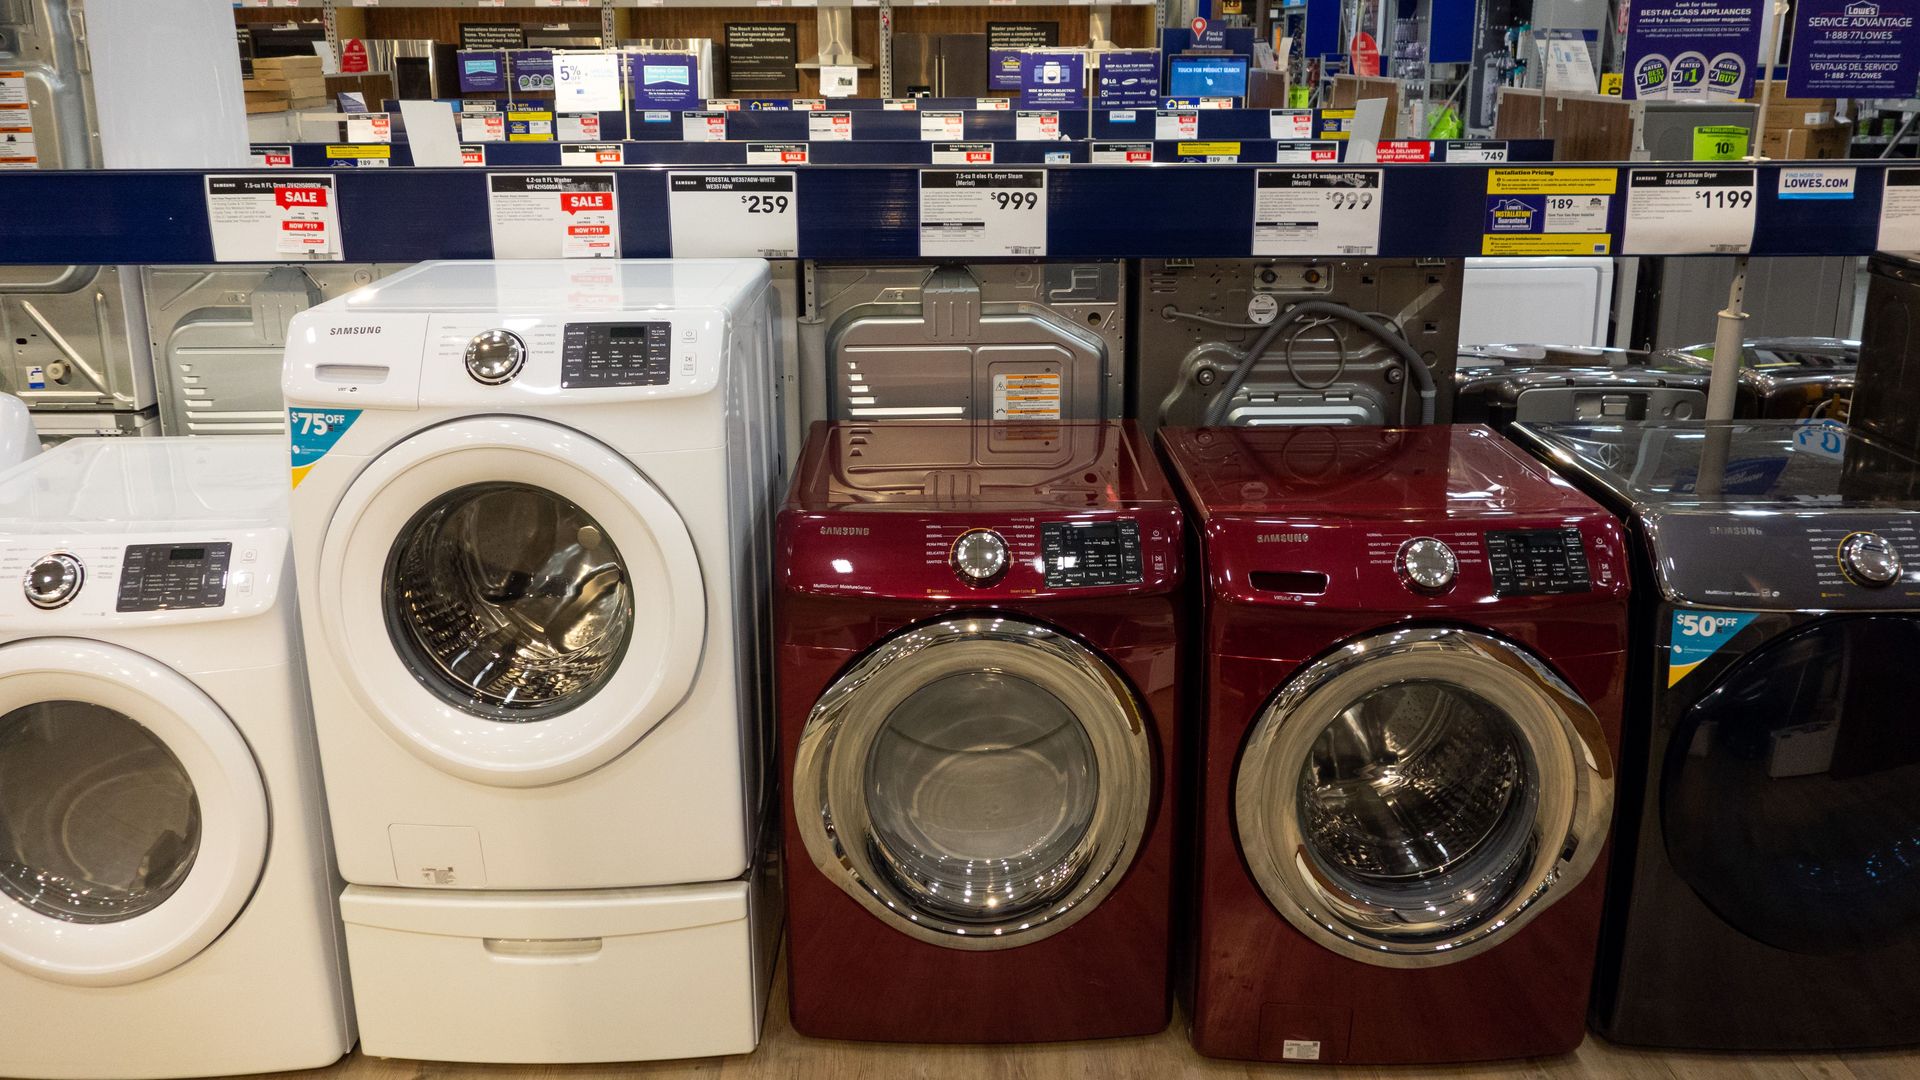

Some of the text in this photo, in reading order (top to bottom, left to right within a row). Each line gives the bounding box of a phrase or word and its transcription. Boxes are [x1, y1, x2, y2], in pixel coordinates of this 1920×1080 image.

[1808, 18, 1912, 27] SERVICE ADVANTAGE
[1648, 68, 1664, 76] BEST
[1648, 74, 1664, 84] BUY
[1684, 72, 1698, 83] #1
[1719, 74, 1736, 84] BUY
[1715, 142, 1729, 154] 10
[1482, 152, 1504, 160] $749
[1784, 179, 1848, 188] LOWES.COM
[286, 192, 318, 202] SALE
[571, 196, 604, 207] SALE
[990, 192, 1038, 210] $999
[1326, 192, 1373, 210] $999
[1696, 190, 1752, 208] $1199
[741, 196, 788, 214] $259
[330, 326, 382, 336] SAMSUNG
[292, 412, 328, 436] $75
[326, 414, 344, 424] OFF
[820, 527, 870, 536] SAMSUNG
[1710, 526, 1762, 535] SAMSUNG
[1257, 534, 1309, 542] SAMSUNG
[1677, 614, 1716, 636] $50
[1716, 618, 1738, 626] OFF
